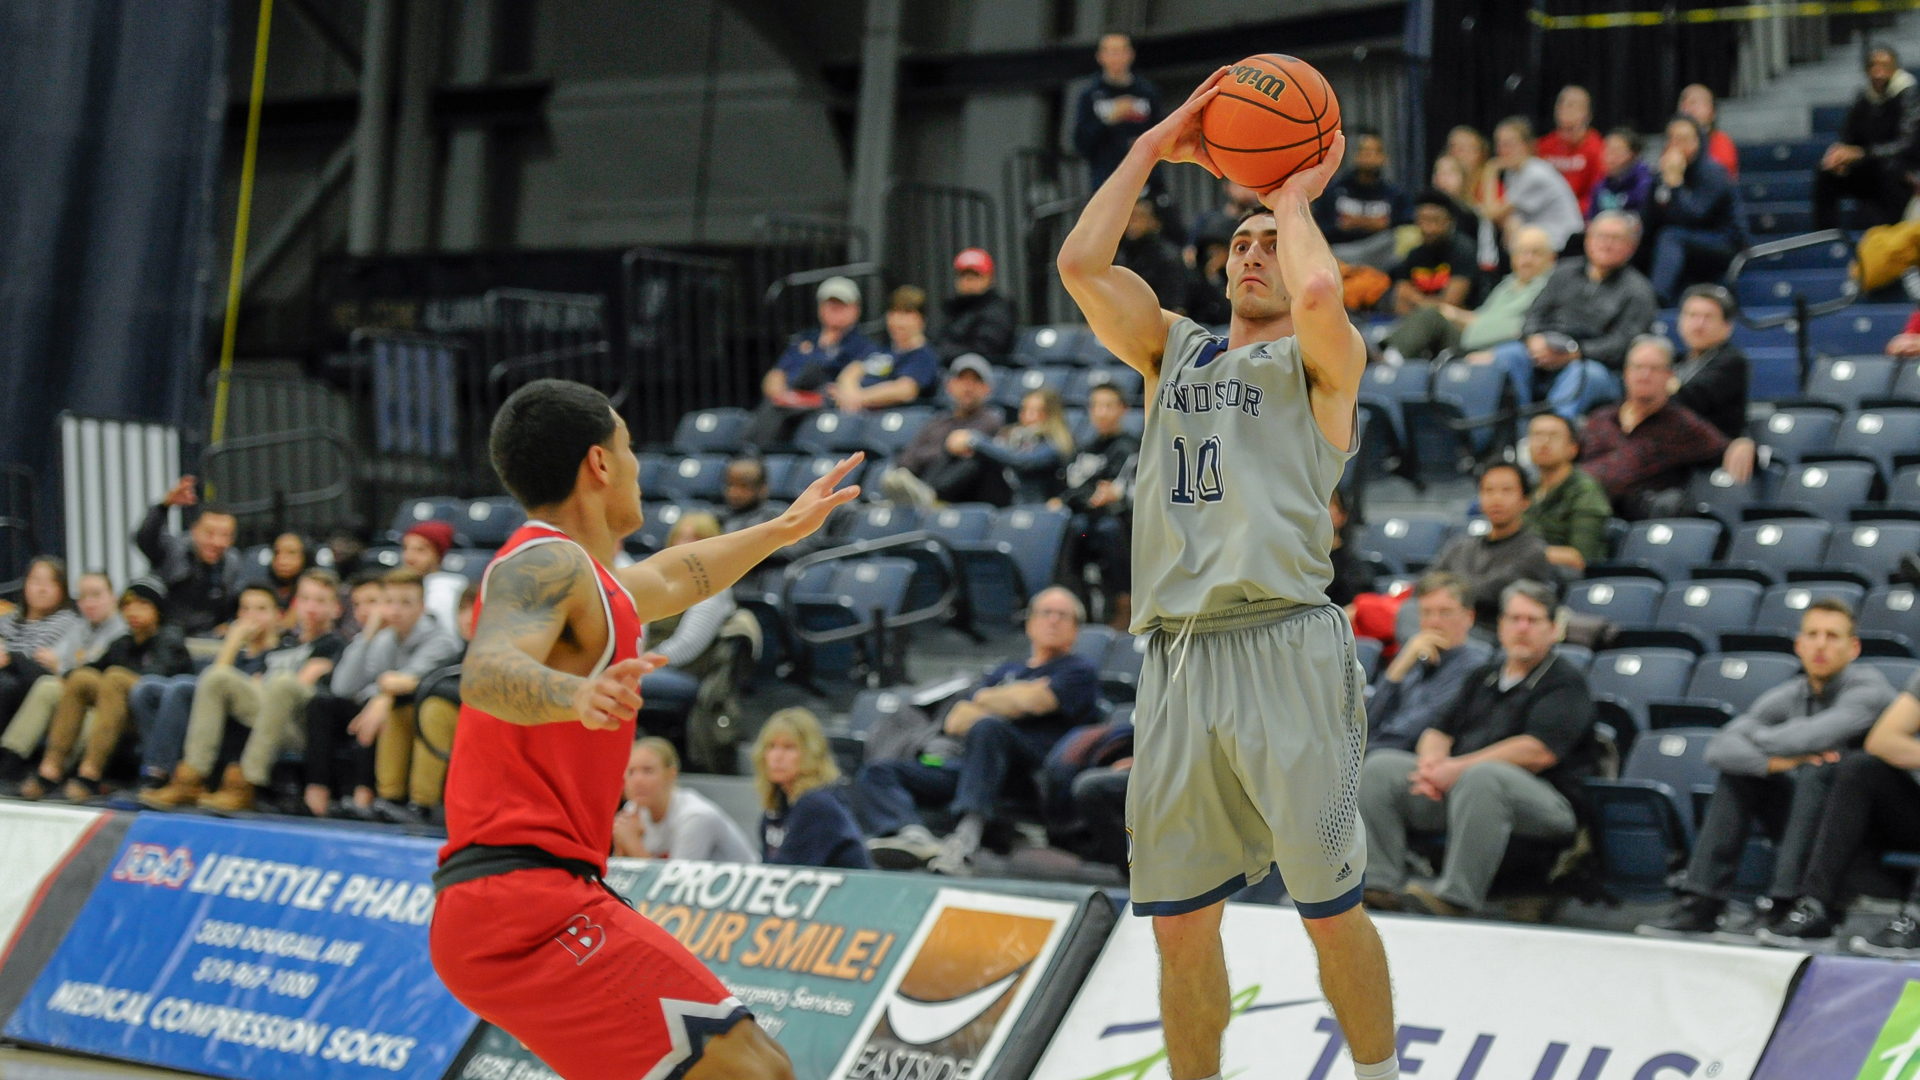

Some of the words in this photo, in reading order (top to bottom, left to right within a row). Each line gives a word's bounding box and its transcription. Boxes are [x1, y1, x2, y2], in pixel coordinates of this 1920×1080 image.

[1225, 65, 1286, 102] Wilso
[1159, 378, 1264, 418] INDSOR
[1170, 434, 1225, 506] 10
[189, 852, 343, 911] LIFESTYLE
[332, 872, 437, 926] PHAR
[646, 859, 844, 920] PROTECT
[240, 925, 326, 962] DOUGALL
[318, 940, 365, 967] AVE
[555, 914, 606, 966] B
[740, 917, 896, 982] SMILE!
[47, 980, 151, 1026] MEDICAL
[150, 996, 331, 1057] COMPRESSION
[321, 1025, 418, 1072] SOCKS
[788, 986, 856, 1017] Services
[845, 1044, 975, 1080] EASTSIDE
